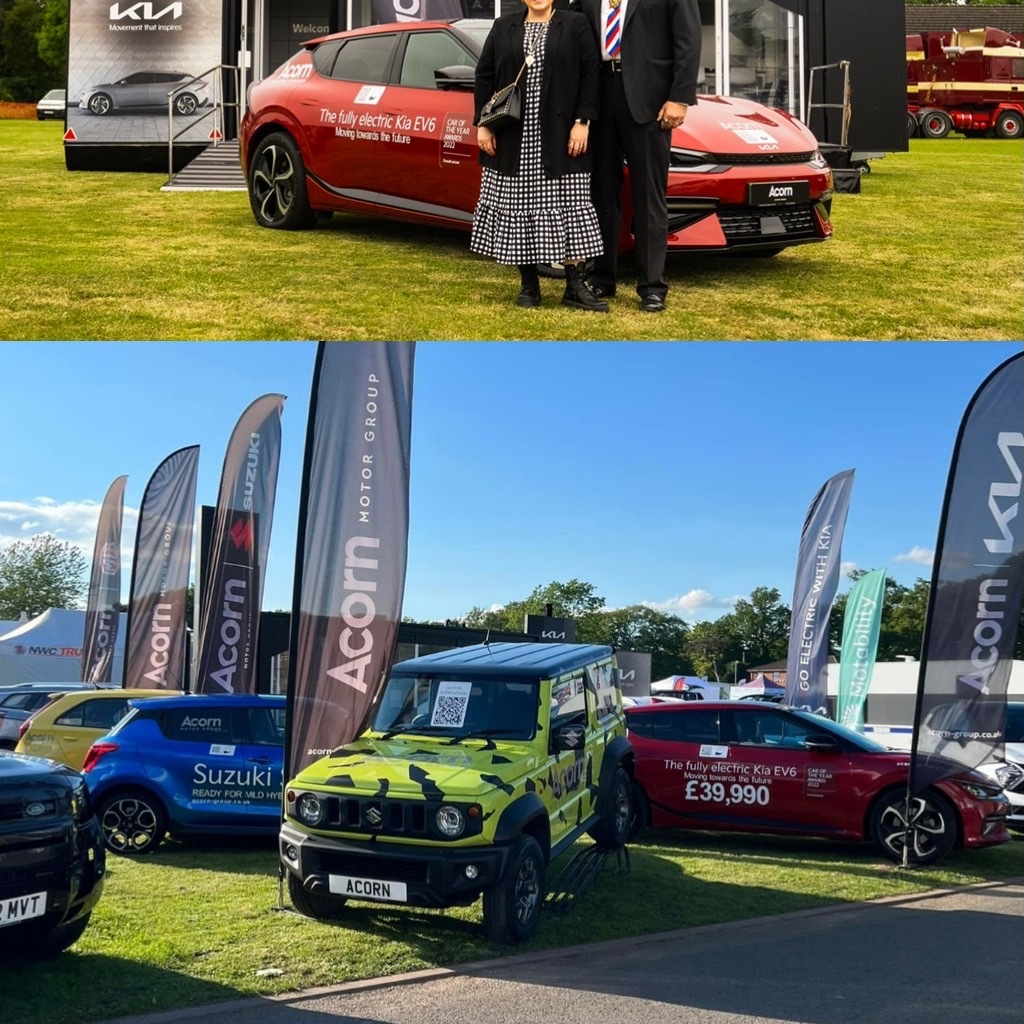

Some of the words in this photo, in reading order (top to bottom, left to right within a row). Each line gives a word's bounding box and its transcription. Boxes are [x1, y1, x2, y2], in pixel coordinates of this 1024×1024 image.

[110, 1, 183, 20] KIA
[158, 24, 182, 32] inspires
[279, 62, 313, 80] Acorn
[320, 108, 337, 123] The
[339, 109, 358, 128] fully
[359, 112, 392, 129] electric
[395, 115, 411, 130] Kia
[414, 116, 437, 133] EV6
[456, 127, 471, 135] YEAR
[335, 127, 355, 140] Moving
[356, 129, 379, 141] towards
[380, 131, 390, 142] the
[392, 133, 411, 144] future
[768, 185, 793, 197] Acorn
[364, 372, 380, 442] GROUP
[358, 453, 374, 523] MOTOR
[818, 524, 832, 550] KIA
[210, 578, 247, 694] Acorn
[243, 432, 261, 511] SUZUKI
[811, 555, 828, 593] WITH
[327, 536, 380, 694] Acorn
[541, 630, 566, 639] KIA
[800, 597, 818, 665] ELECTRIC
[958, 579, 1008, 695] Acorn
[28, 647, 58, 655] NWC
[143, 603, 172, 687] Acorn
[850, 595, 876, 698] Motability
[799, 670, 811, 692] GO
[181, 716, 222, 727] Acorn
[193, 763, 272, 786] Suzuki
[664, 759, 683, 770] The
[686, 761, 709, 773] fully
[711, 763, 750, 775] electric
[754, 765, 771, 776] Kia
[774, 766, 797, 777] EV6
[684, 772, 708, 781] Moving
[709, 774, 737, 783] towards
[738, 776, 749, 784] the
[751, 777, 772, 785] future
[192, 789, 221, 798] READY
[225, 790, 242, 798] FOR
[245, 790, 264, 799] MILD
[267, 791, 284, 800] HYB
[685, 780, 770, 806] £39,990
[346, 879, 392, 898] ACORN
[8, 895, 41, 919] MVT
